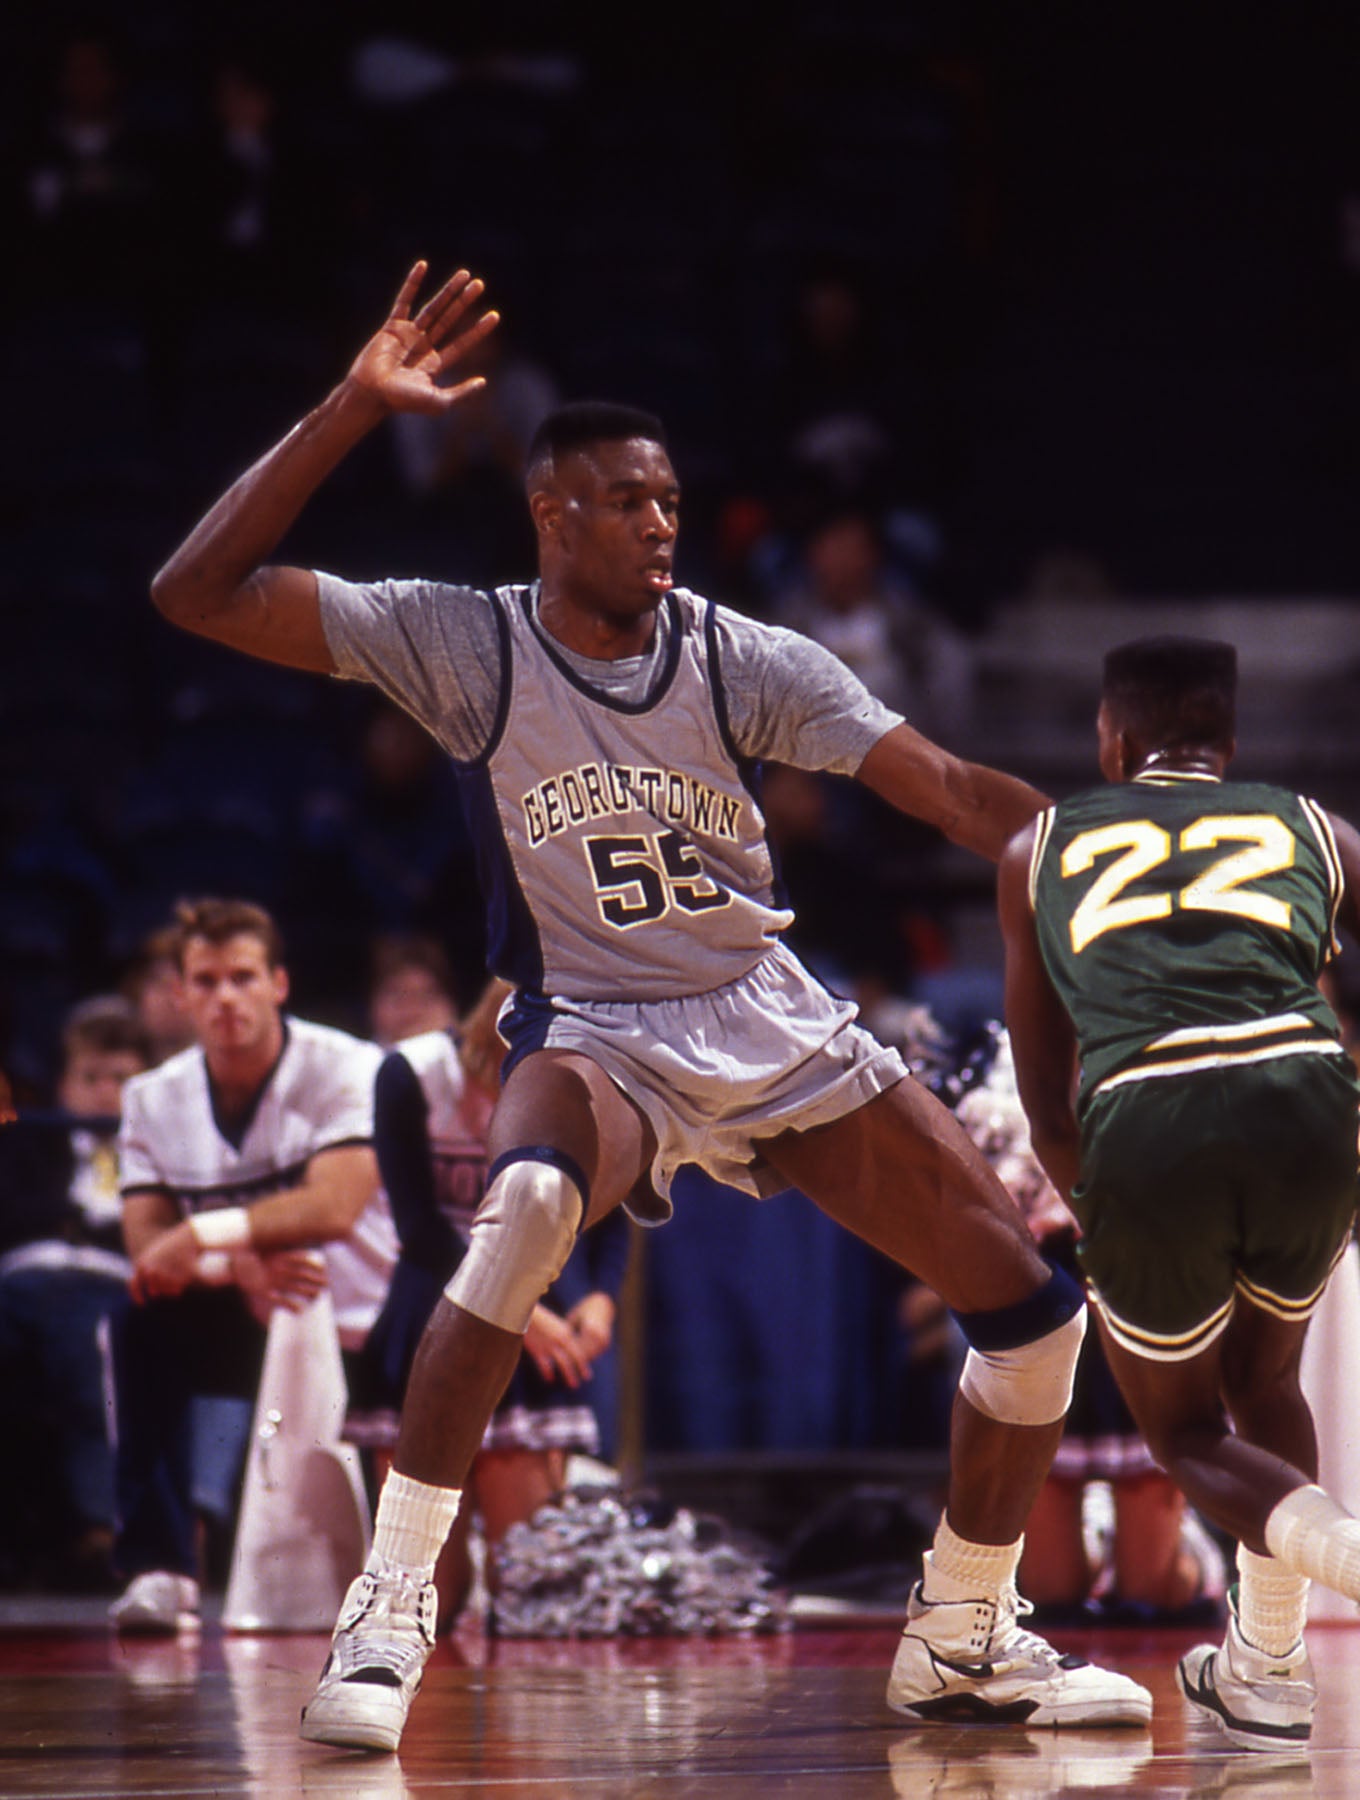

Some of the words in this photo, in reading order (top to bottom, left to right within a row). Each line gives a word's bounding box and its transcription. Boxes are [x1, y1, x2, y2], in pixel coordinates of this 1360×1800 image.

[521, 762, 743, 848] GEORGTOWN
[582, 829, 733, 931] 55
[1061, 815, 1295, 954] 22
